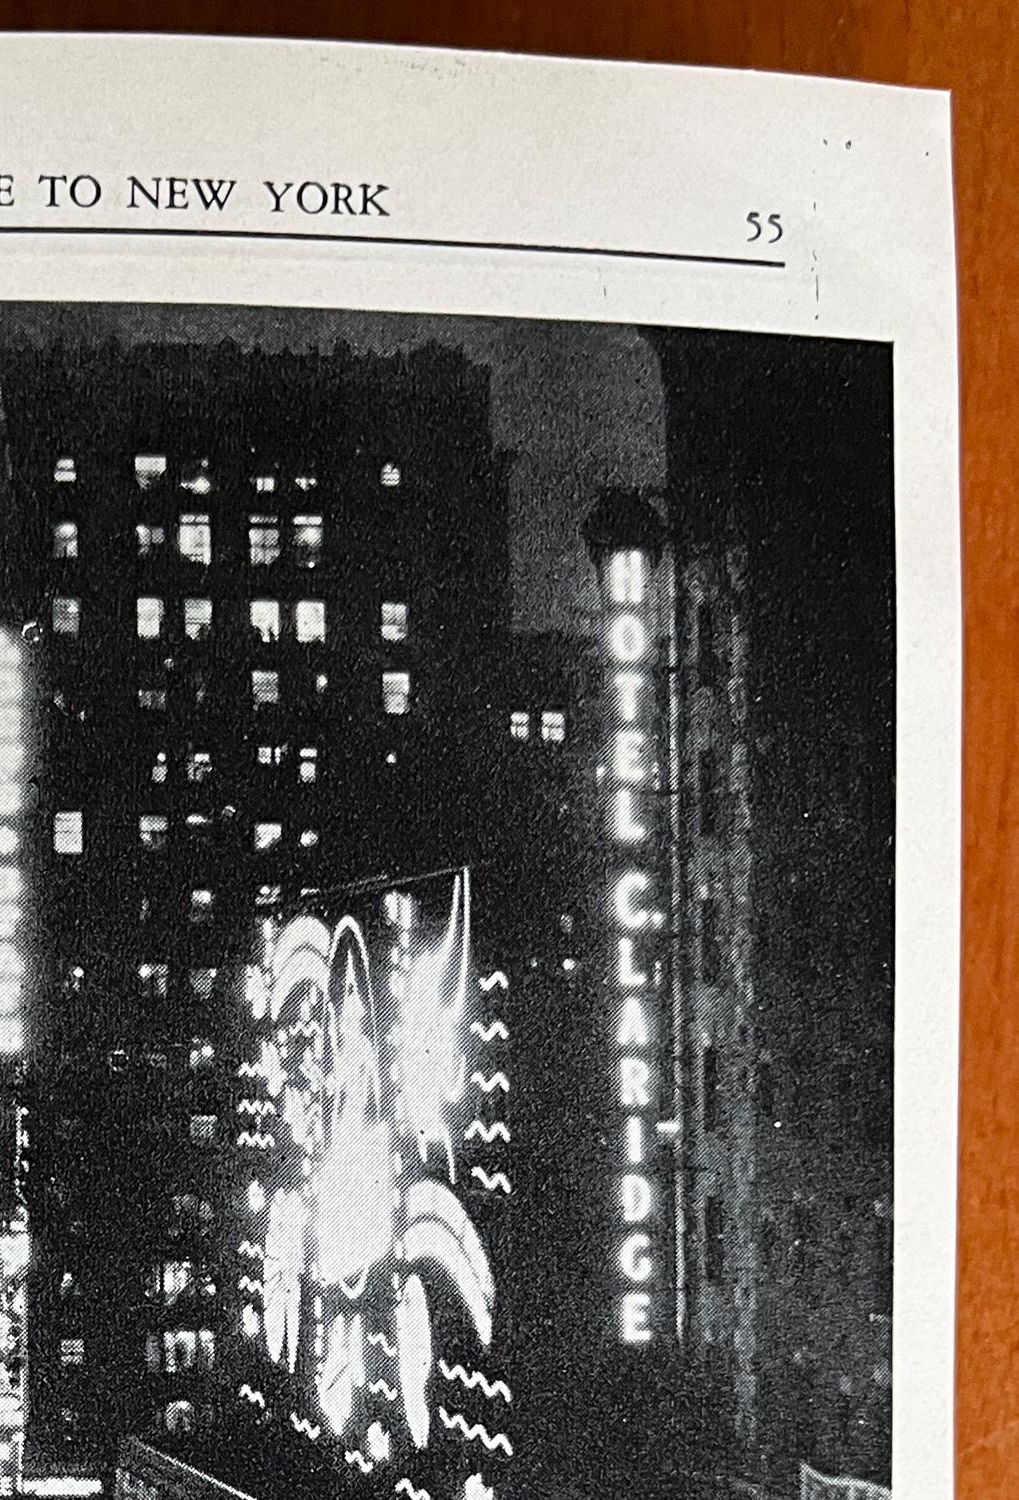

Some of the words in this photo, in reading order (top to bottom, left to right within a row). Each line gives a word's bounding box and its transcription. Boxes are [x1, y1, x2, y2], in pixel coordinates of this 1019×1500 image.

[38, 175, 101, 208] TO
[127, 176, 237, 211] NEW
[263, 181, 390, 216] YORK
[747, 212, 782, 243] 55
[608, 547, 649, 843] HOTEL
[611, 870, 653, 1343] CLARIDGE
